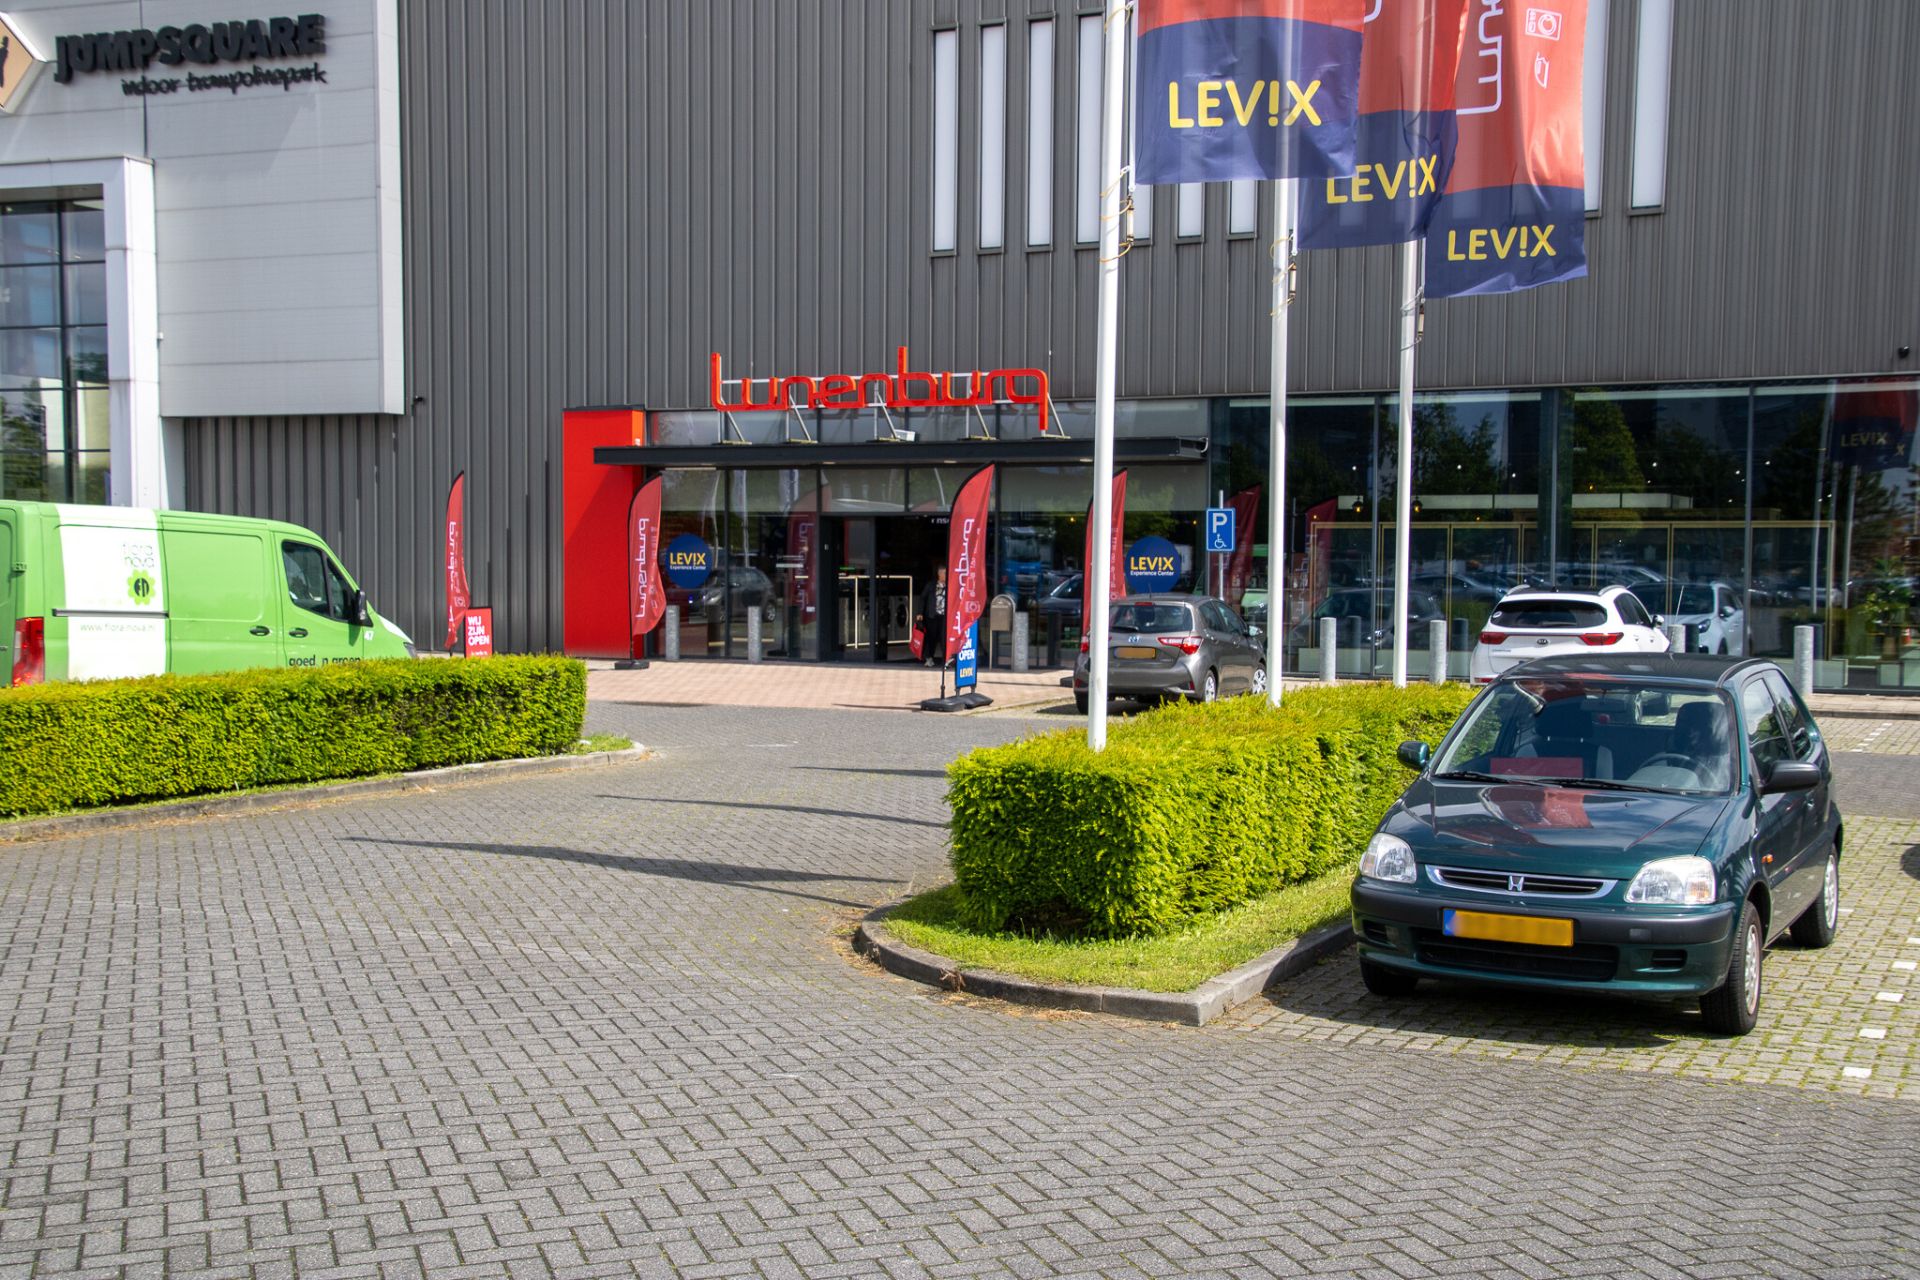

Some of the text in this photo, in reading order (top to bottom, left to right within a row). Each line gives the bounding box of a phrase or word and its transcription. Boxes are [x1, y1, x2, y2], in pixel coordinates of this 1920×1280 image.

[120, 75, 181, 96] indoor
[711, 345, 1048, 431] lunenburg
[1212, 512, 1228, 534] P
[635, 518, 650, 618] lunenburg
[468, 635, 490, 646] OPEN
[958, 649, 975, 661] OPEN
